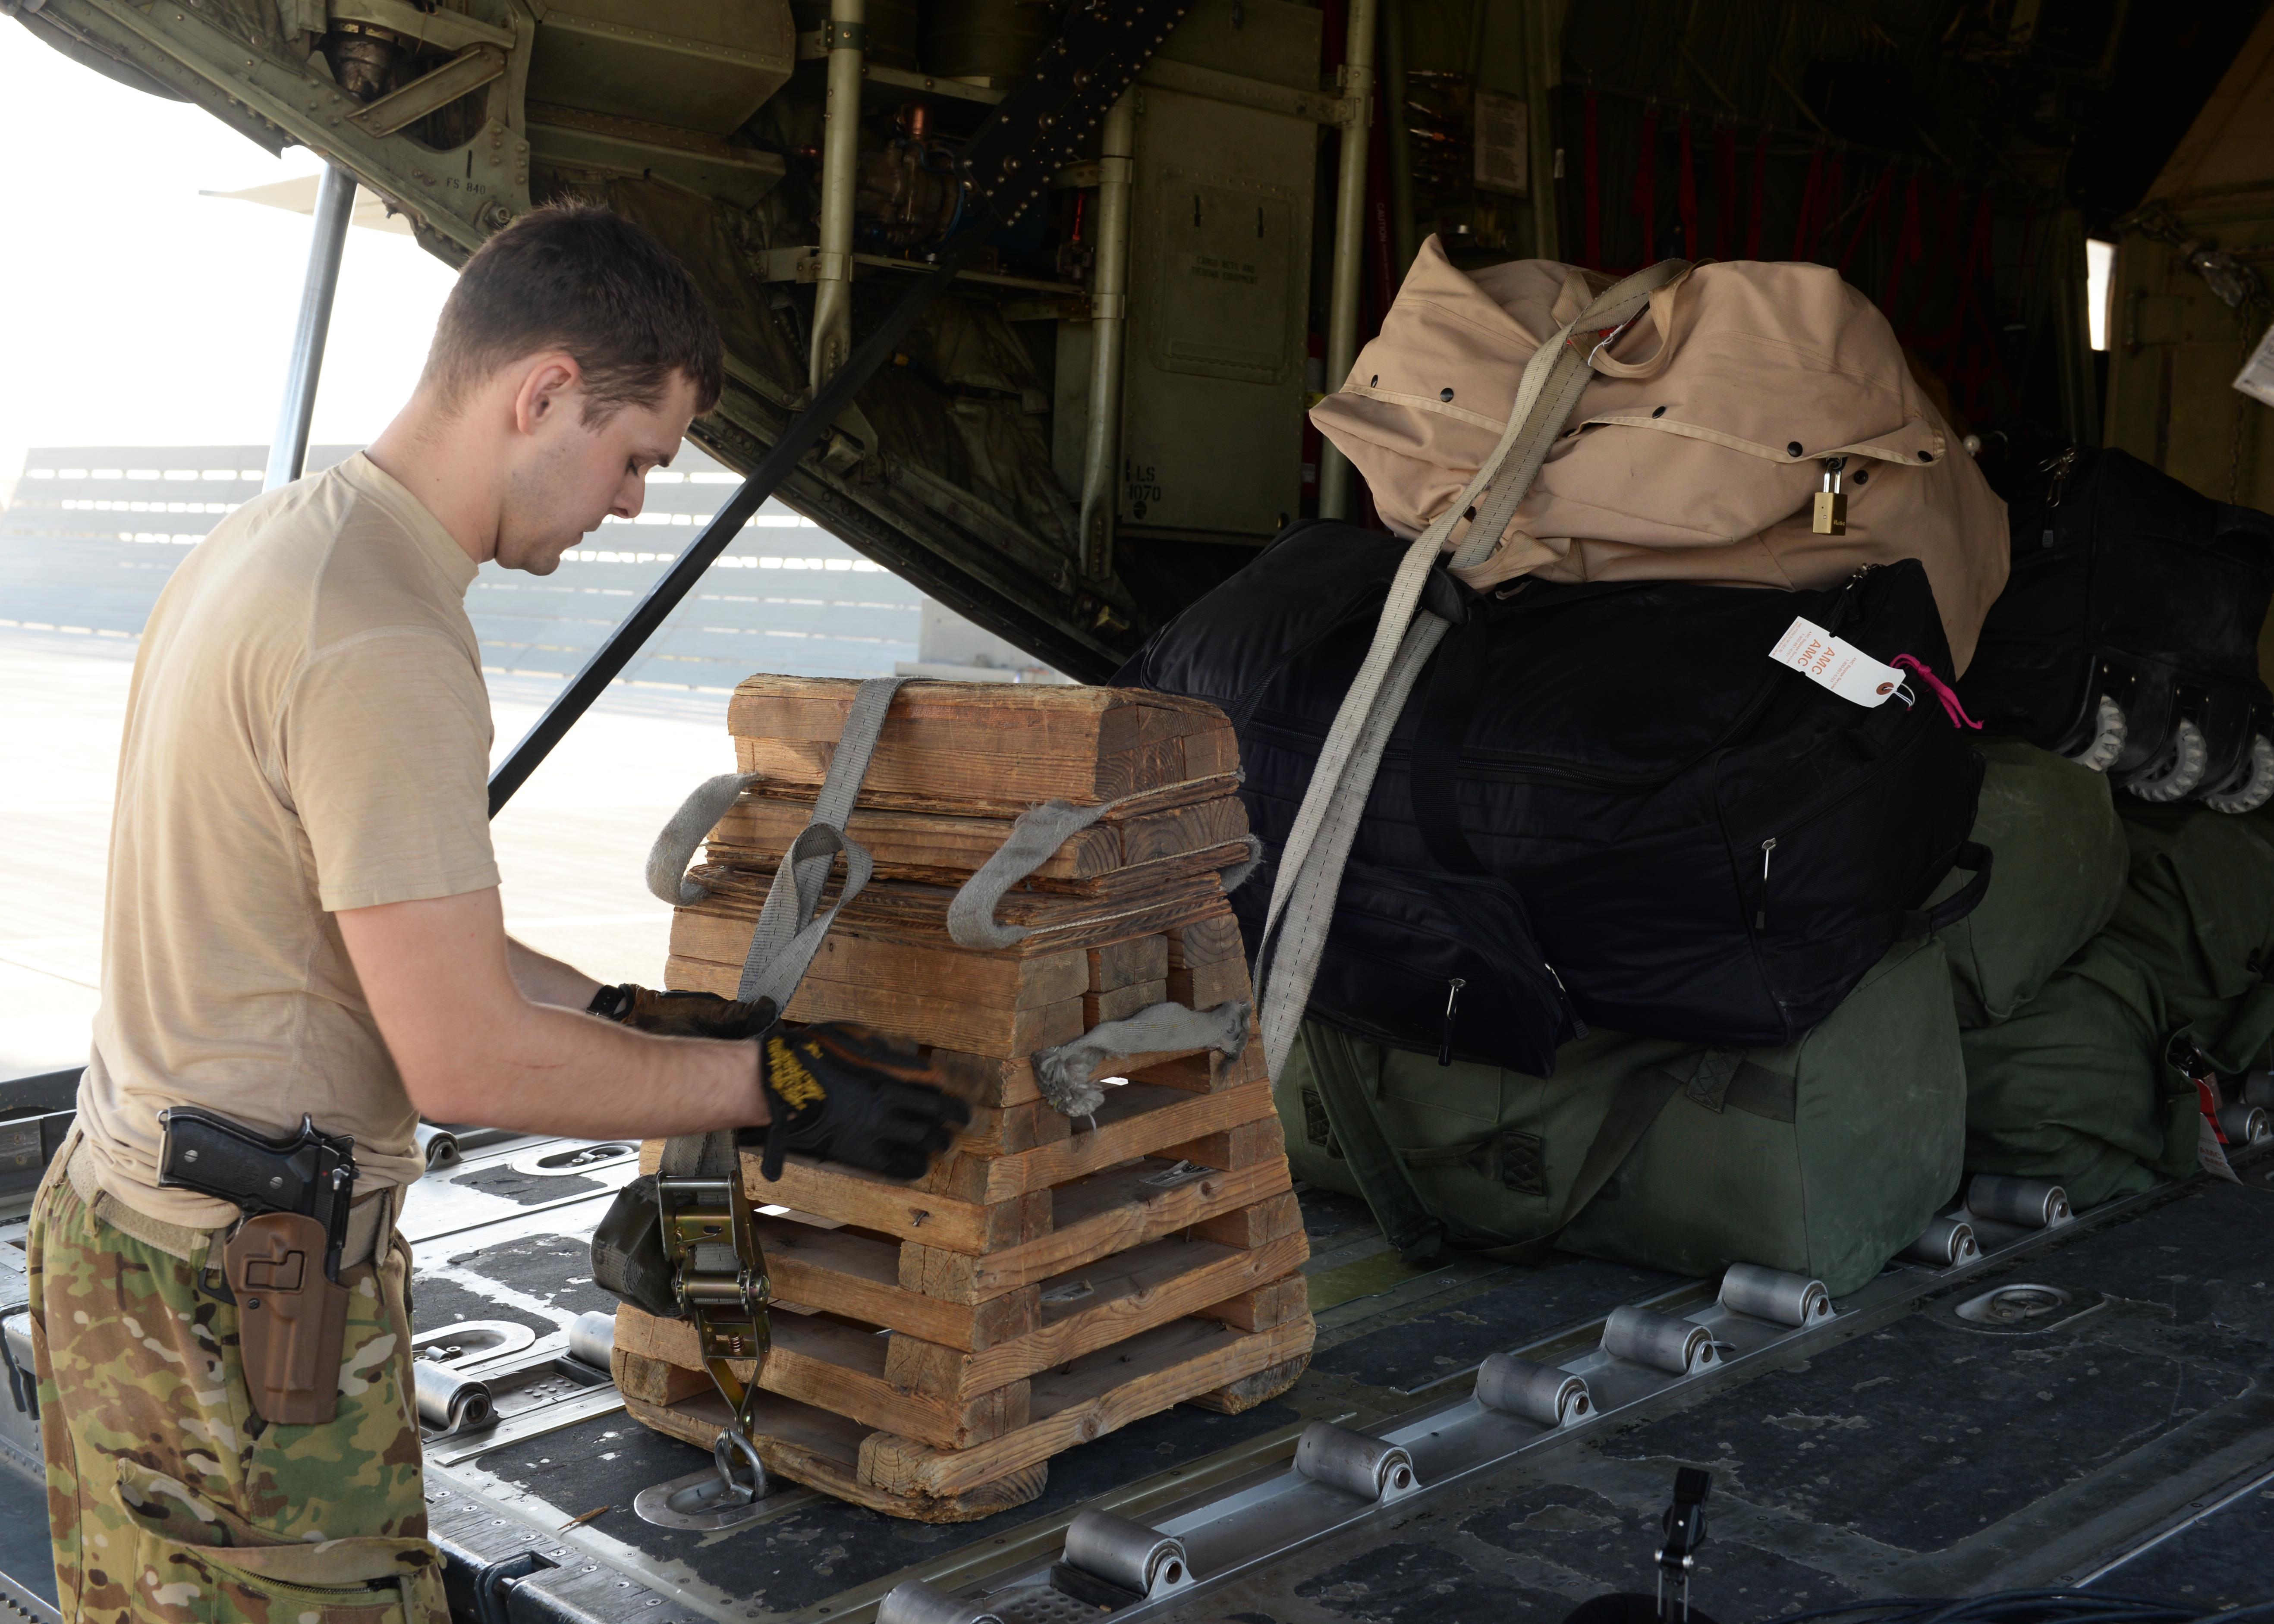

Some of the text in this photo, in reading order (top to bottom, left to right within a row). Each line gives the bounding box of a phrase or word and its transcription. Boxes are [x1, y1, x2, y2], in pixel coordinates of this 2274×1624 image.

[447, 177, 486, 195] FS 840
[1376, 201, 1388, 243] CAUTION
[1196, 256, 1256, 273] CARGO NETS AND
[1137, 465, 1154, 482] LS
[1129, 484, 1161, 502] 1070
[1798, 639, 1821, 666] AMC
[1812, 647, 1835, 675] AMC
[2199, 1146, 2222, 1159] AMC
[2205, 1157, 2227, 1169] AMC
